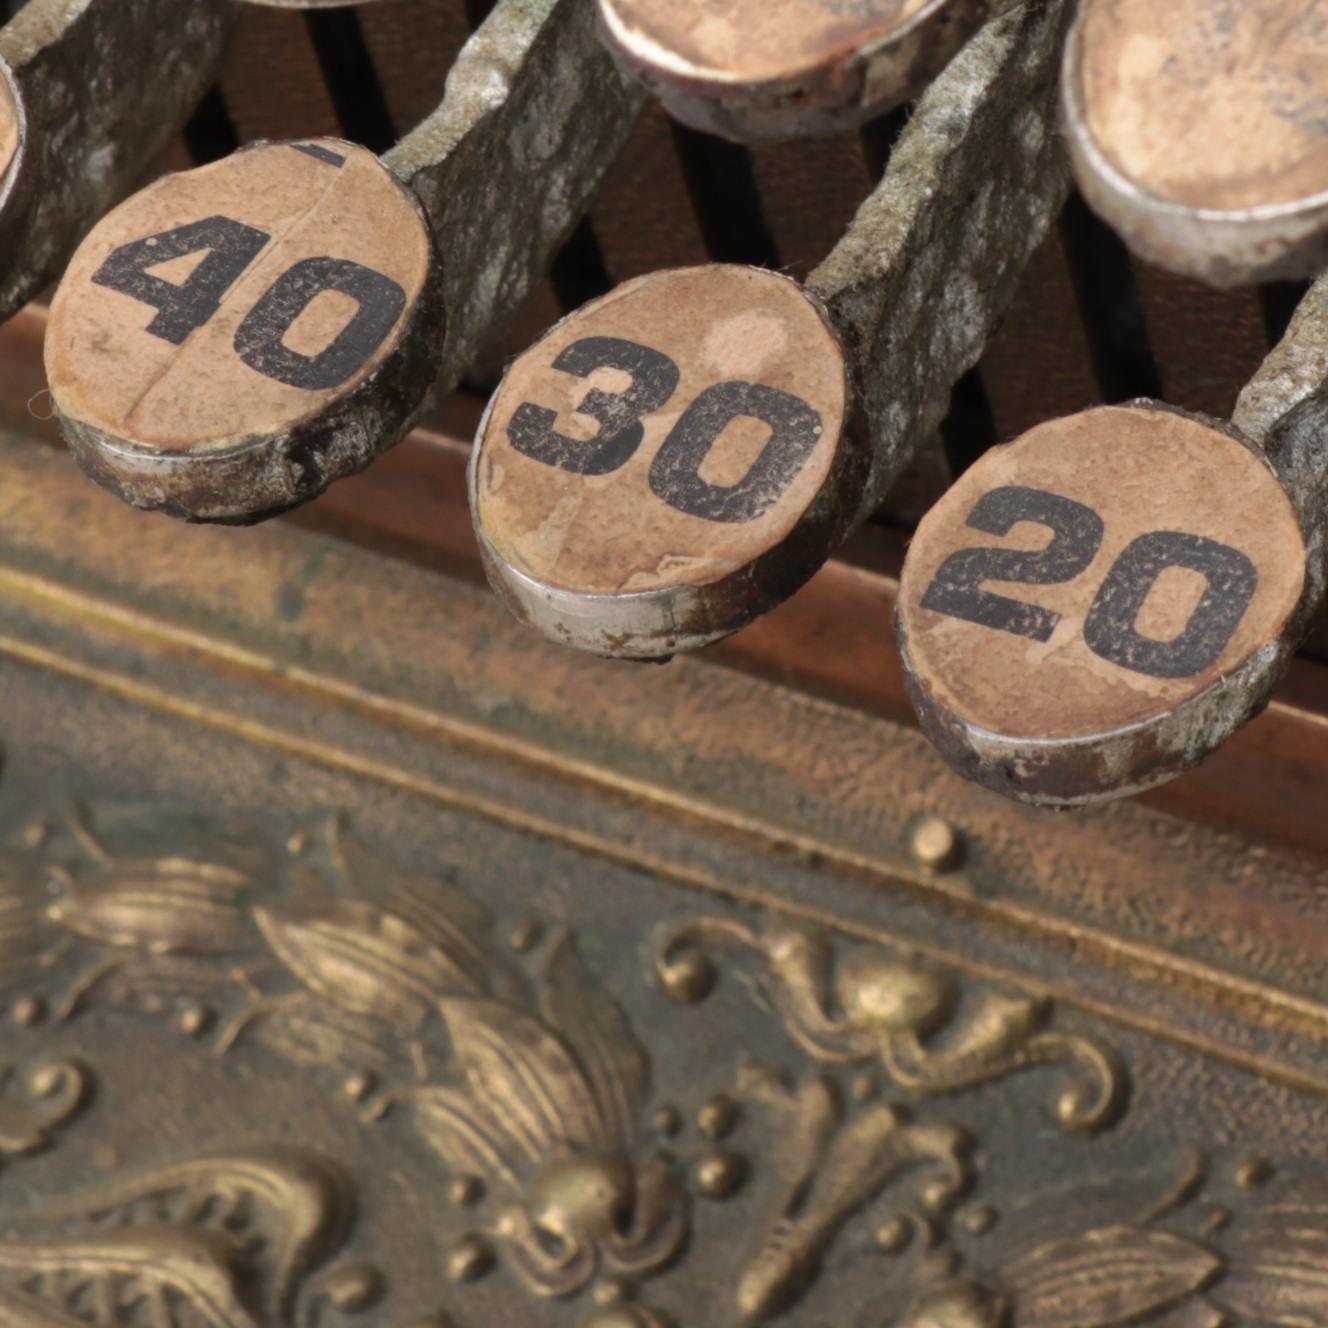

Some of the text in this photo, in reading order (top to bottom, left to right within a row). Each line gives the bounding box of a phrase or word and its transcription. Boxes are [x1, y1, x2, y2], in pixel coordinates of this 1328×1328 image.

[91, 215, 406, 390] 40
[508, 336, 824, 523] 30
[920, 485, 1258, 678] 20
